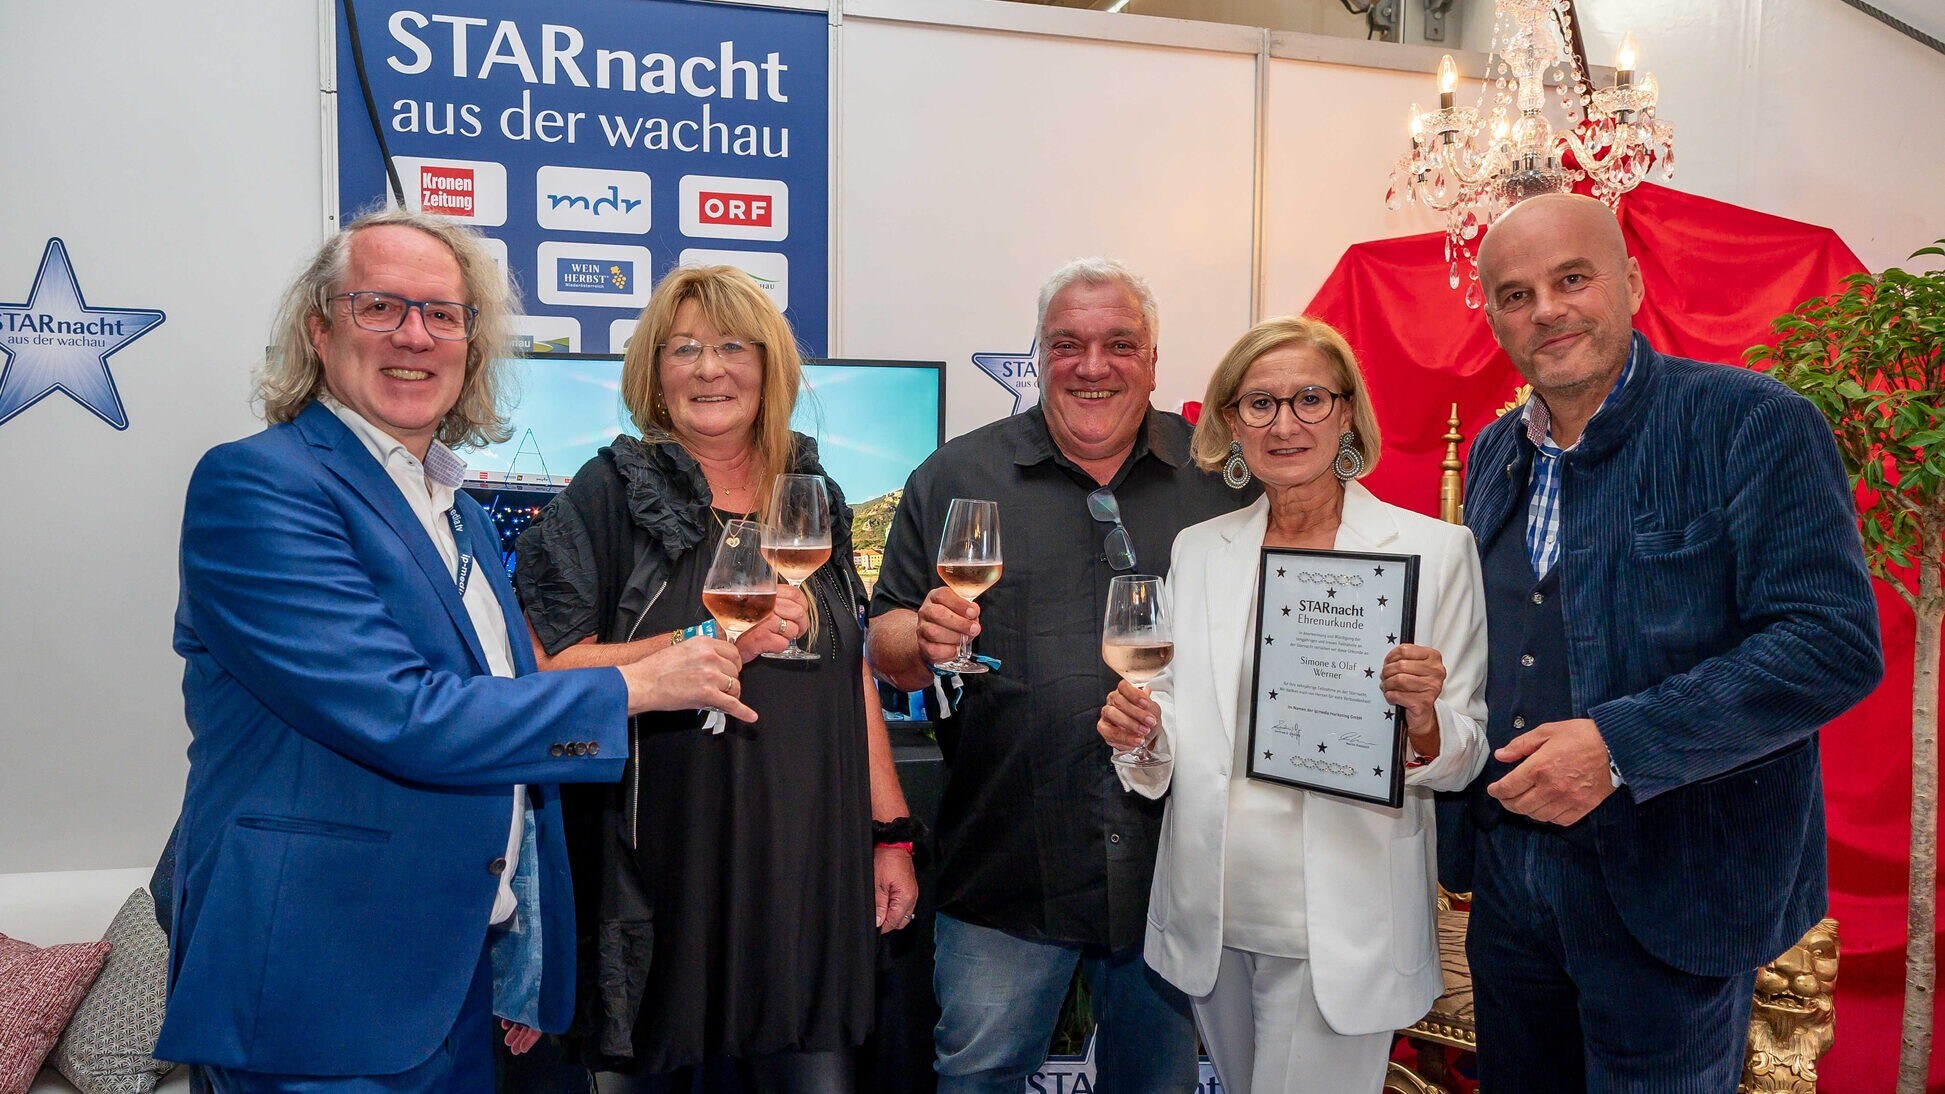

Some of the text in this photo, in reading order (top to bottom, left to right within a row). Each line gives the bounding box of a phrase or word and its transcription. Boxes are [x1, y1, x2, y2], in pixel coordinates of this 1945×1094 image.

[387, 10, 788, 103] STARnacht
[392, 89, 789, 158] aus der wachau
[422, 172, 472, 191] Kronen
[423, 191, 472, 210] Zeitung
[547, 185, 641, 215] mdr
[704, 198, 767, 220] ORF
[571, 263, 600, 273] WEIN
[564, 273, 606, 284] HERBST
[0, 312, 124, 336] TARnacht
[7, 334, 106, 348] aus der wachau
[1002, 361, 1038, 378] STA
[1298, 599, 1365, 617] STARnacht
[1297, 613, 1365, 630] Ehrenurkunde
[1300, 655, 1358, 671] Simone & Olaf
[1313, 667, 1342, 680] Werner
[1028, 1072, 1094, 1094] STA
